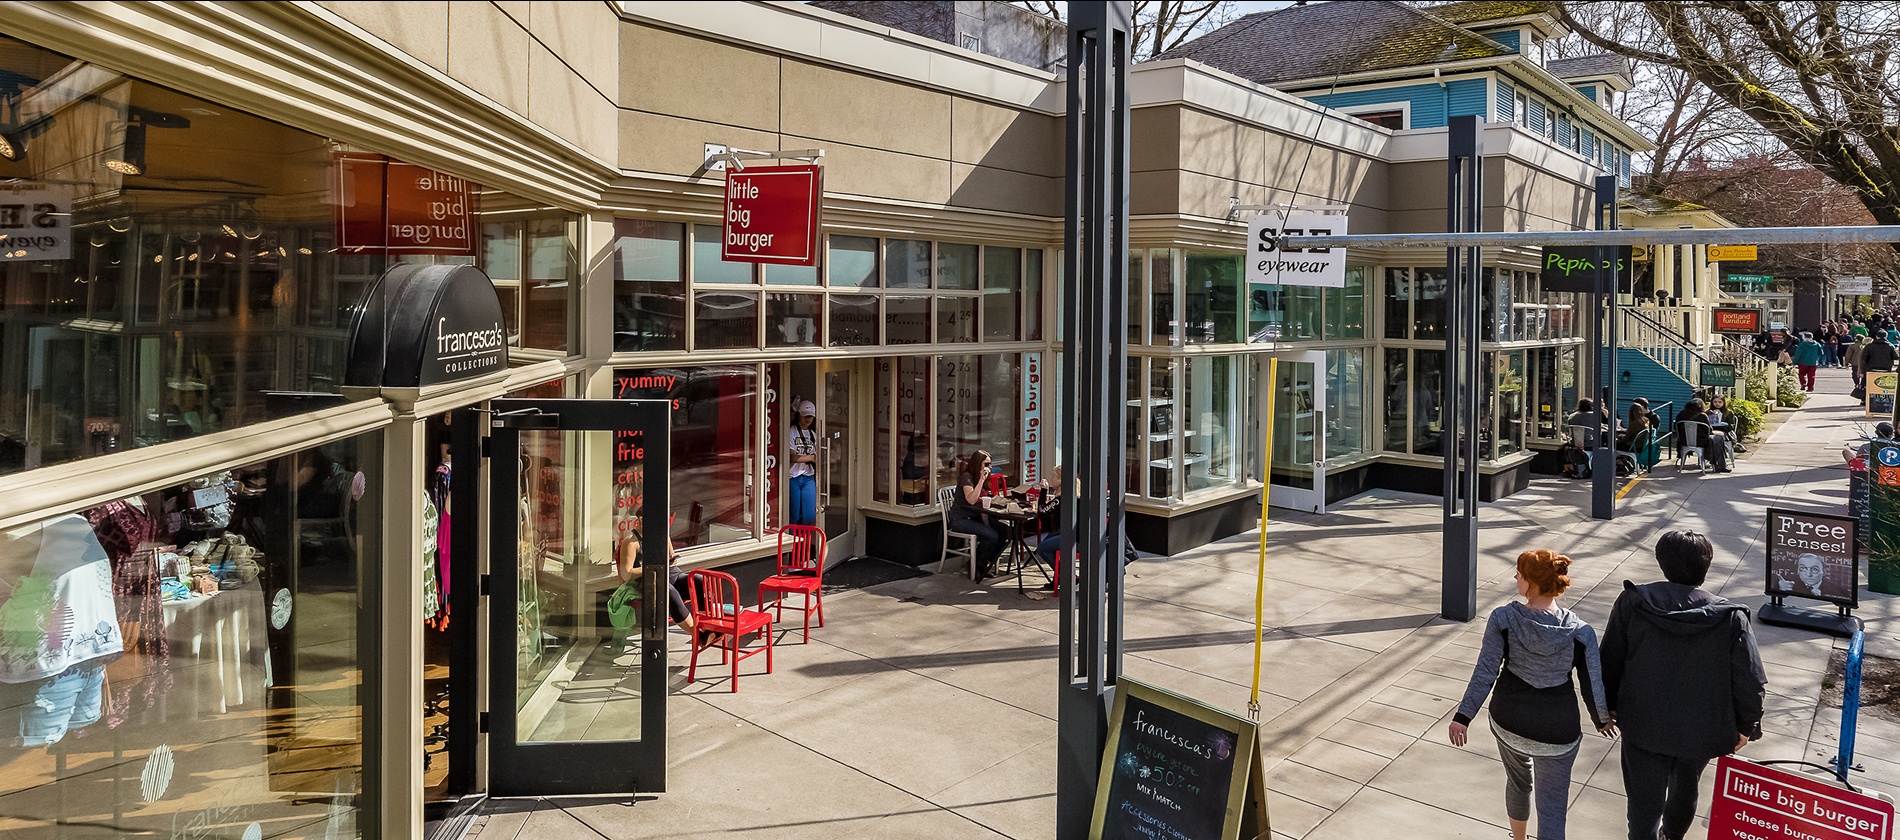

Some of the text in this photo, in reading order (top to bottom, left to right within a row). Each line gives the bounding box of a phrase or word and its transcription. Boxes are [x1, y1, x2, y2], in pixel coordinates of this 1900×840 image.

[730, 178, 759, 199] little
[729, 202, 751, 228] big
[728, 225, 774, 252] burger
[1258, 259, 1330, 275] eyewear
[831, 307, 898, 324] hambuer
[1722, 313, 1751, 321] portland
[437, 317, 503, 354] francesca's
[445, 355, 499, 374] COLLECTIONS
[618, 375, 677, 394] yummy
[883, 382, 914, 399] sda
[1025, 355, 1040, 411] burger
[1025, 417, 1040, 443] big
[617, 441, 644, 461] frie
[1777, 515, 1846, 539] Free
[1777, 534, 1846, 553] lenses!
[1733, 777, 1880, 833] little big burger
[1734, 810, 1780, 832] cheese
